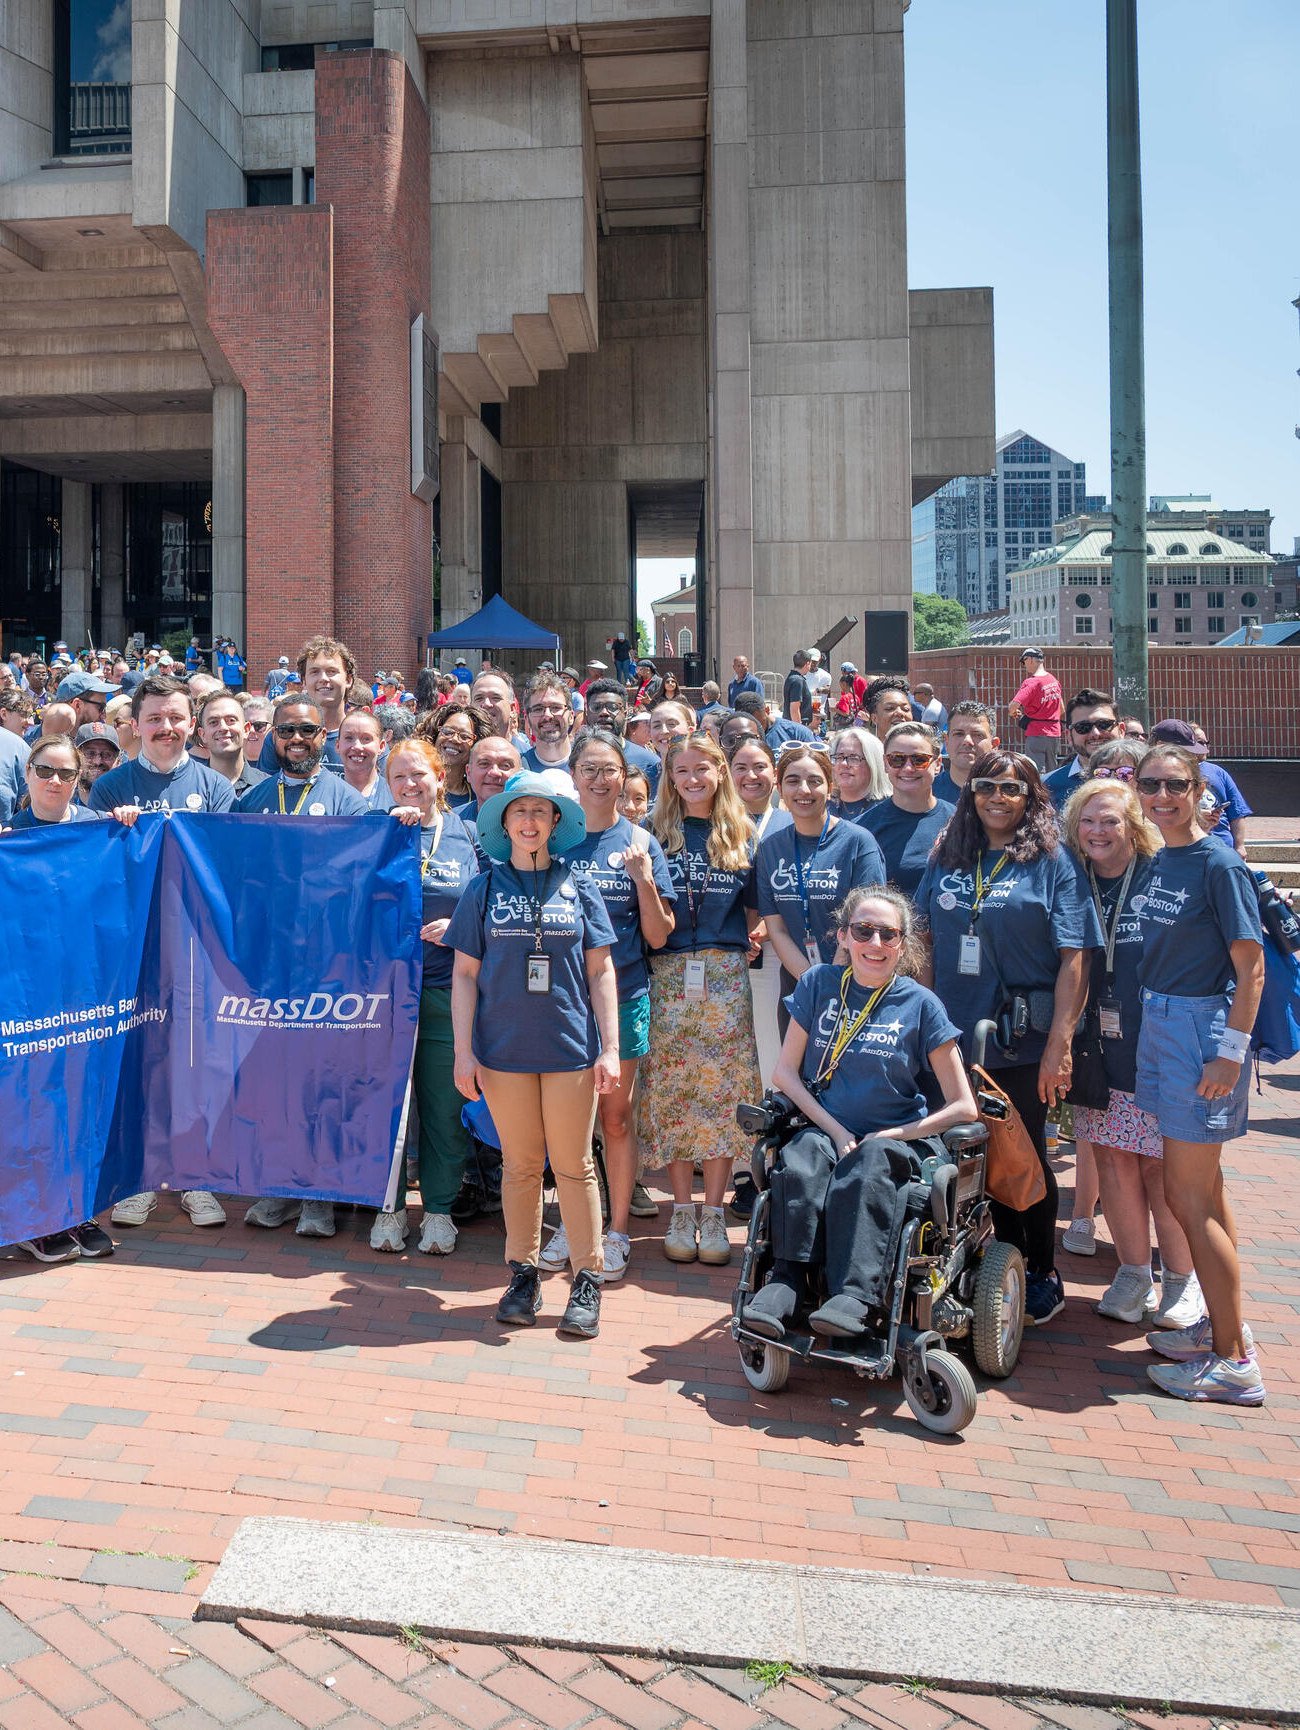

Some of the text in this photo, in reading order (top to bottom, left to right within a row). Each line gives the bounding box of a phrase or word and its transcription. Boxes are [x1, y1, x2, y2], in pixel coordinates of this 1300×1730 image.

[145, 799, 170, 809] ADA
[570, 860, 599, 870] ADA
[788, 863, 811, 871] AA
[423, 869, 460, 878] OSTON
[963, 874, 990, 883] AA
[594, 879, 630, 890] OSTON
[804, 880, 838, 889] STON
[1151, 876, 1161, 887] DA
[516, 904, 531, 913] 35
[1148, 897, 1182, 914] BOSTON
[524, 913, 575, 924] BSTON
[218, 992, 389, 1021] massDOT
[1, 996, 139, 1037] Massachusetts Bay
[843, 1008, 871, 1023] AD
[216, 1016, 267, 1027] Massachusetts
[268, 1021, 314, 1029] Department
[325, 1022, 381, 1030] Transportation
[2, 1007, 168, 1058] Transportation Authority
[855, 1033, 898, 1046] OSTON
